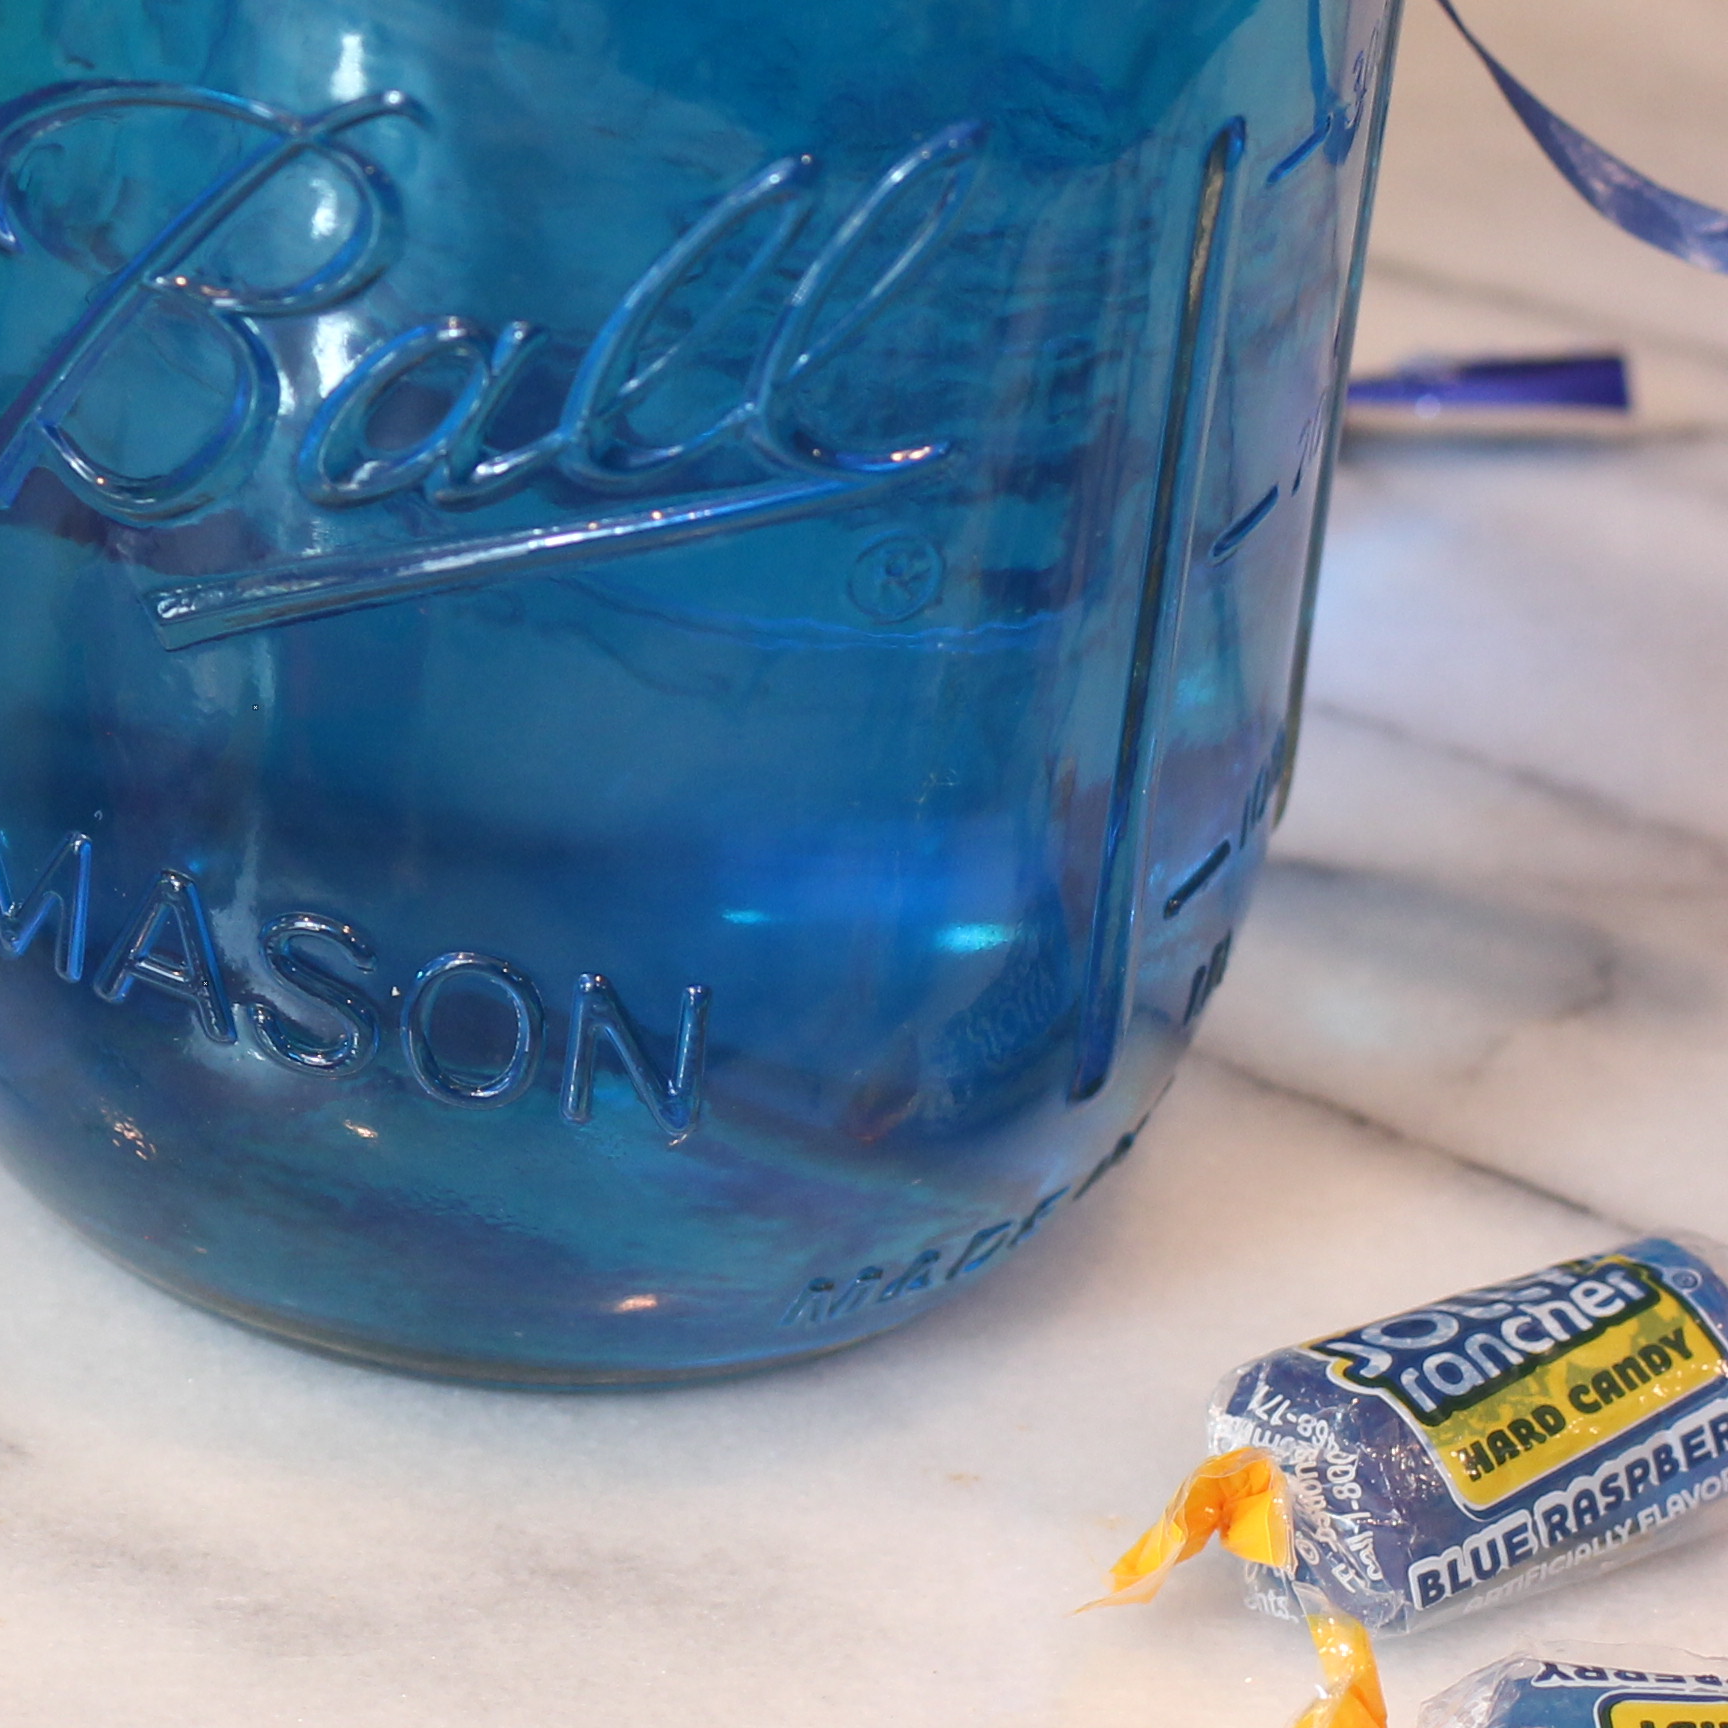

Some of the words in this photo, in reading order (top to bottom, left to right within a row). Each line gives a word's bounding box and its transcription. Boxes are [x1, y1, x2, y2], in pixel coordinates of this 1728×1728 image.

[1400, 1270, 1647, 1414] rancher
[1458, 1402, 1568, 1482] HARD
[1567, 1327, 1694, 1415] CANDY
[1416, 1522, 1536, 1609] BLUE
[1462, 1516, 1633, 1614] ARTIFICIALLY
